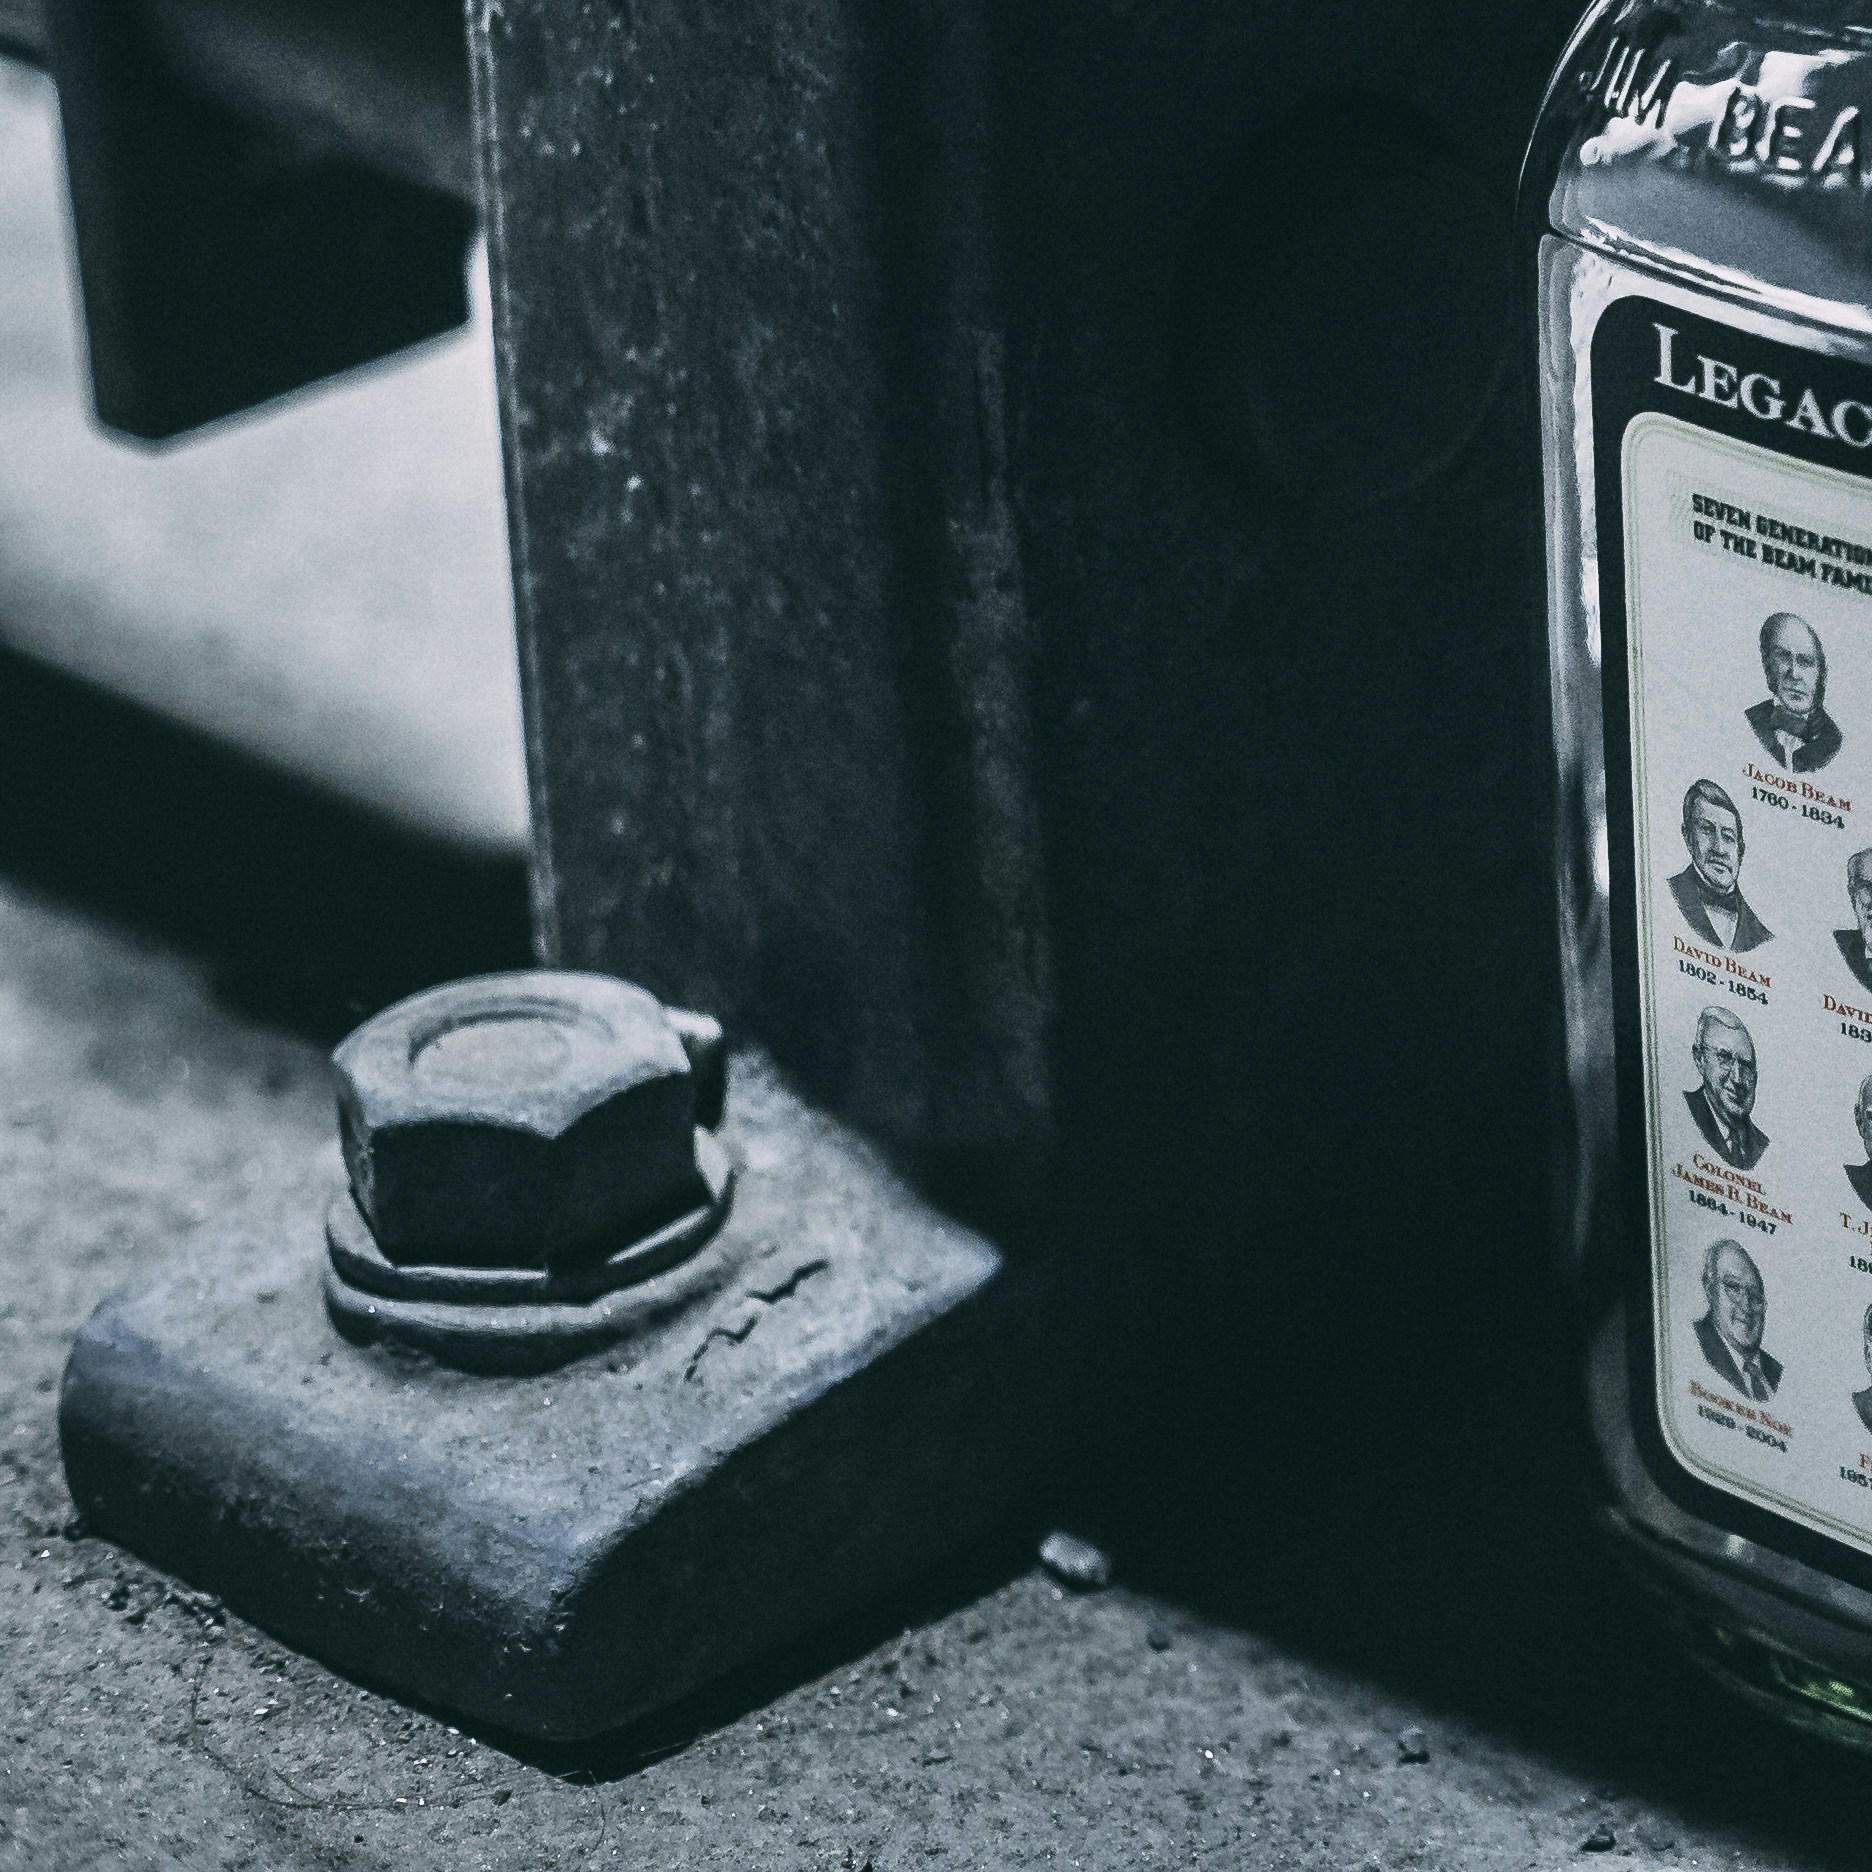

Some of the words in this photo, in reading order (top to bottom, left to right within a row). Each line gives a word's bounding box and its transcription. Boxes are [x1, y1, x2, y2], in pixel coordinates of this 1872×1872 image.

[1692, 493, 1752, 530] SEVEN
[1693, 520, 1716, 544] OF
[1720, 530, 1757, 559] THE
[1762, 543, 1816, 579] BEAM
